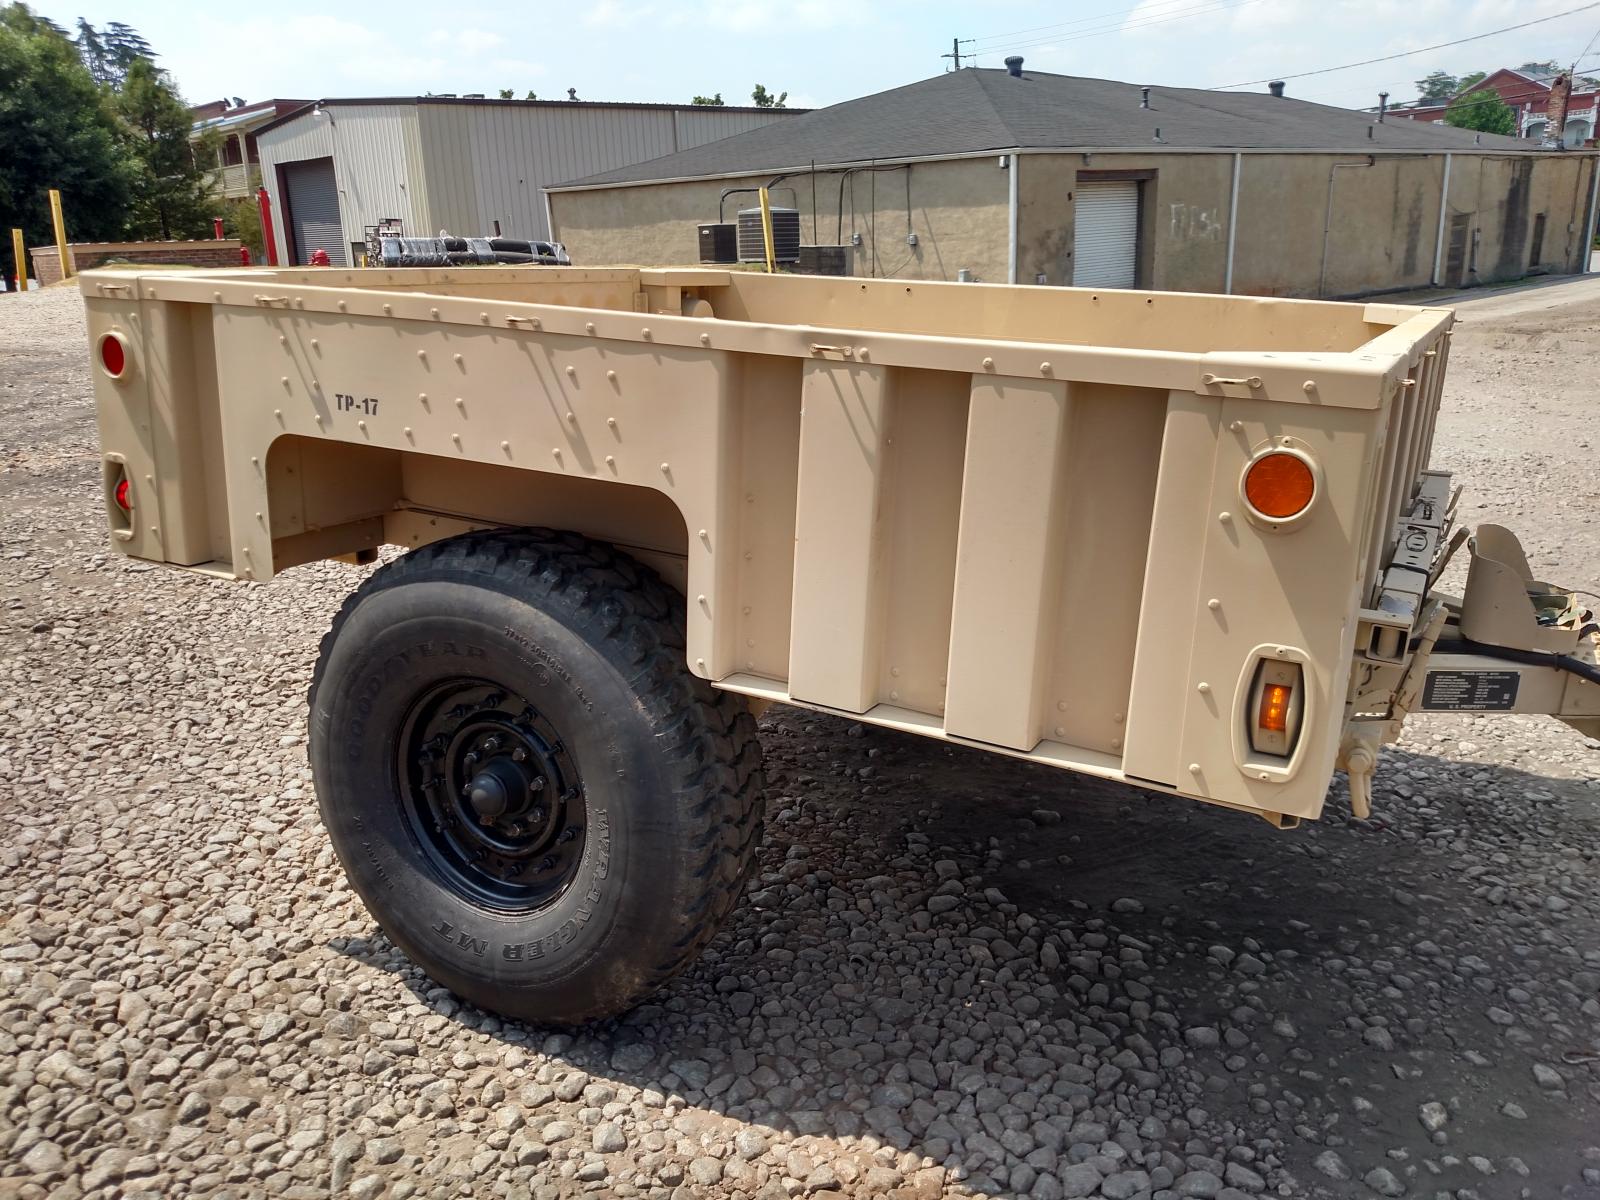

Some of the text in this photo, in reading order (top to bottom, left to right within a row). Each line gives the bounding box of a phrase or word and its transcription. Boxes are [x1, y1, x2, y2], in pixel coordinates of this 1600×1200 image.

[335, 393, 378, 416] TP-17
[349, 640, 487, 760] GOODYEAR
[431, 919, 489, 958] MT
